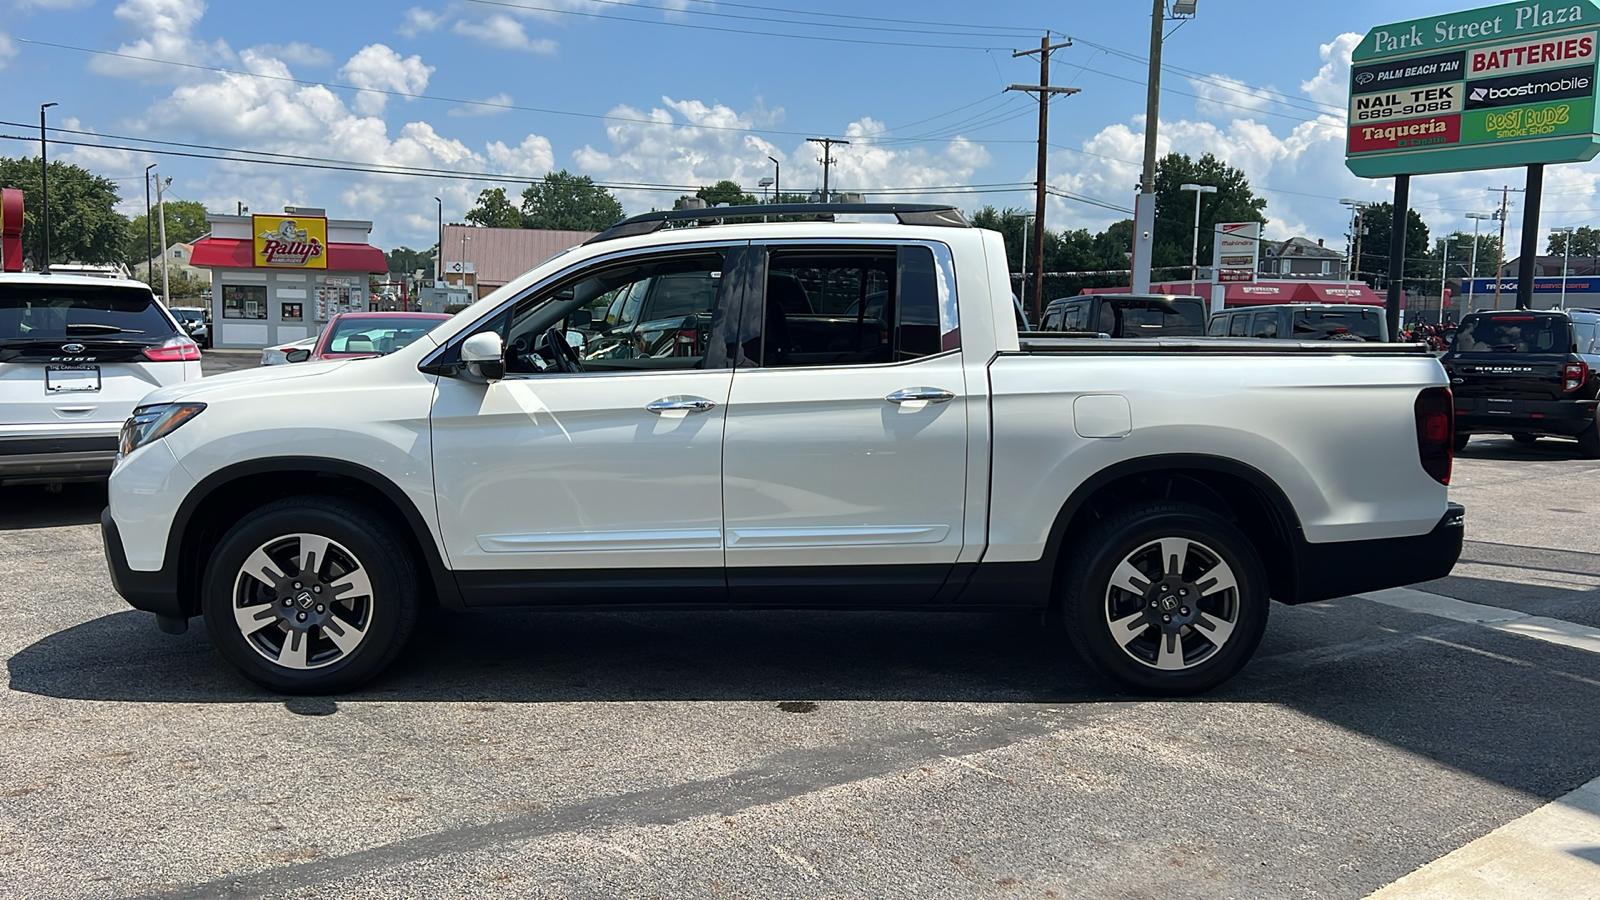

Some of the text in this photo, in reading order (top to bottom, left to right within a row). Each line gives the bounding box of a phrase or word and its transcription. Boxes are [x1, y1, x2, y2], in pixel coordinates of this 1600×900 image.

[1374, 4, 1582, 52] Park Street Plaza
[1472, 37, 1592, 72] BATTERIES
[1377, 61, 1460, 81] PALM BEACH TAN
[1357, 86, 1453, 110] NAIL TEK
[1358, 101, 1452, 120] 689-9088
[1496, 125, 1556, 138] SMOKE SHOP
[261, 238, 322, 263] Rally's
